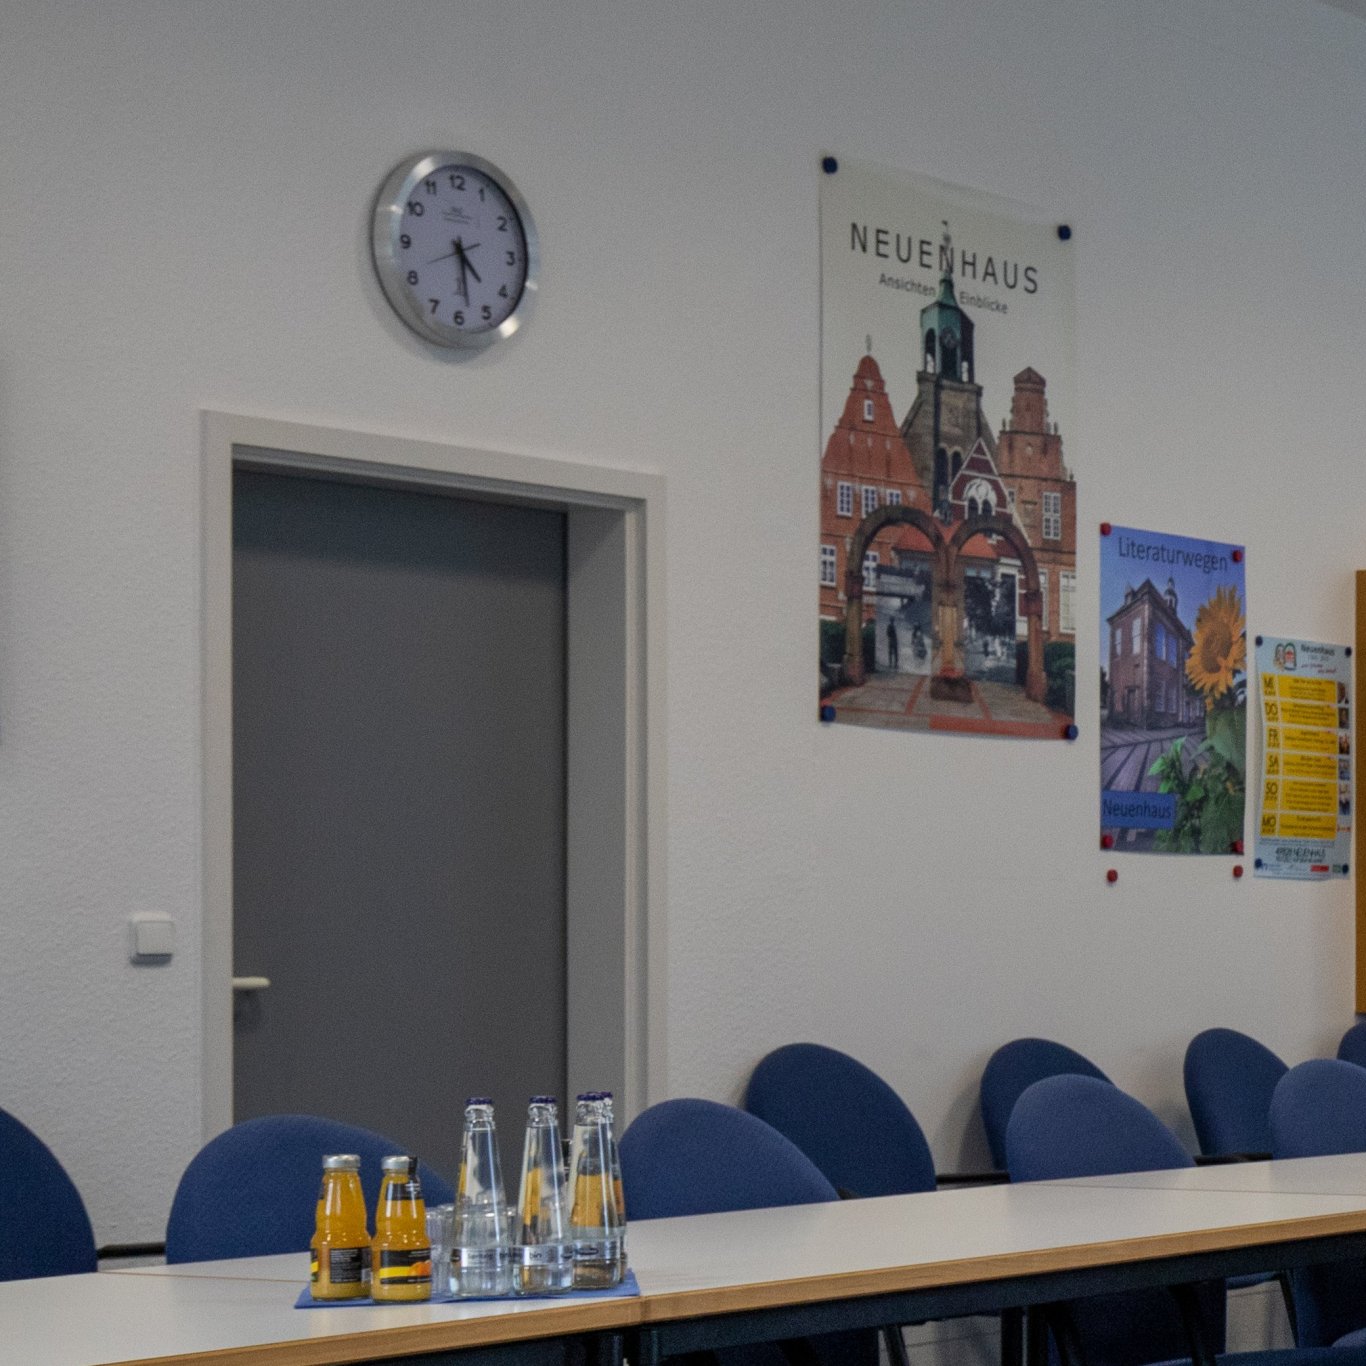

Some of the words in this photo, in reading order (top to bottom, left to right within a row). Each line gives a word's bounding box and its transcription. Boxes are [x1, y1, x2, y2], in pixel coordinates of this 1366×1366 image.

[425, 180, 437, 196] 11
[450, 175, 466, 191] 12
[478, 188, 485, 203] 1
[407, 201, 424, 217] 10
[497, 216, 508, 232] 2
[400, 234, 411, 249] 9
[506, 251, 515, 266] 3
[851, 222, 1038, 294] NEUENHAUS
[407, 270, 419, 285] 8
[498, 285, 508, 299] 4
[879, 273, 936, 297] Ansichten
[959, 291, 1008, 314] Einblicke
[429, 299, 440, 314] 7
[481, 305, 492, 320] 5
[454, 311, 465, 326] 6
[1118, 537, 1228, 574] Literaturwegen
[1103, 799, 1172, 819] Neuenhaus
